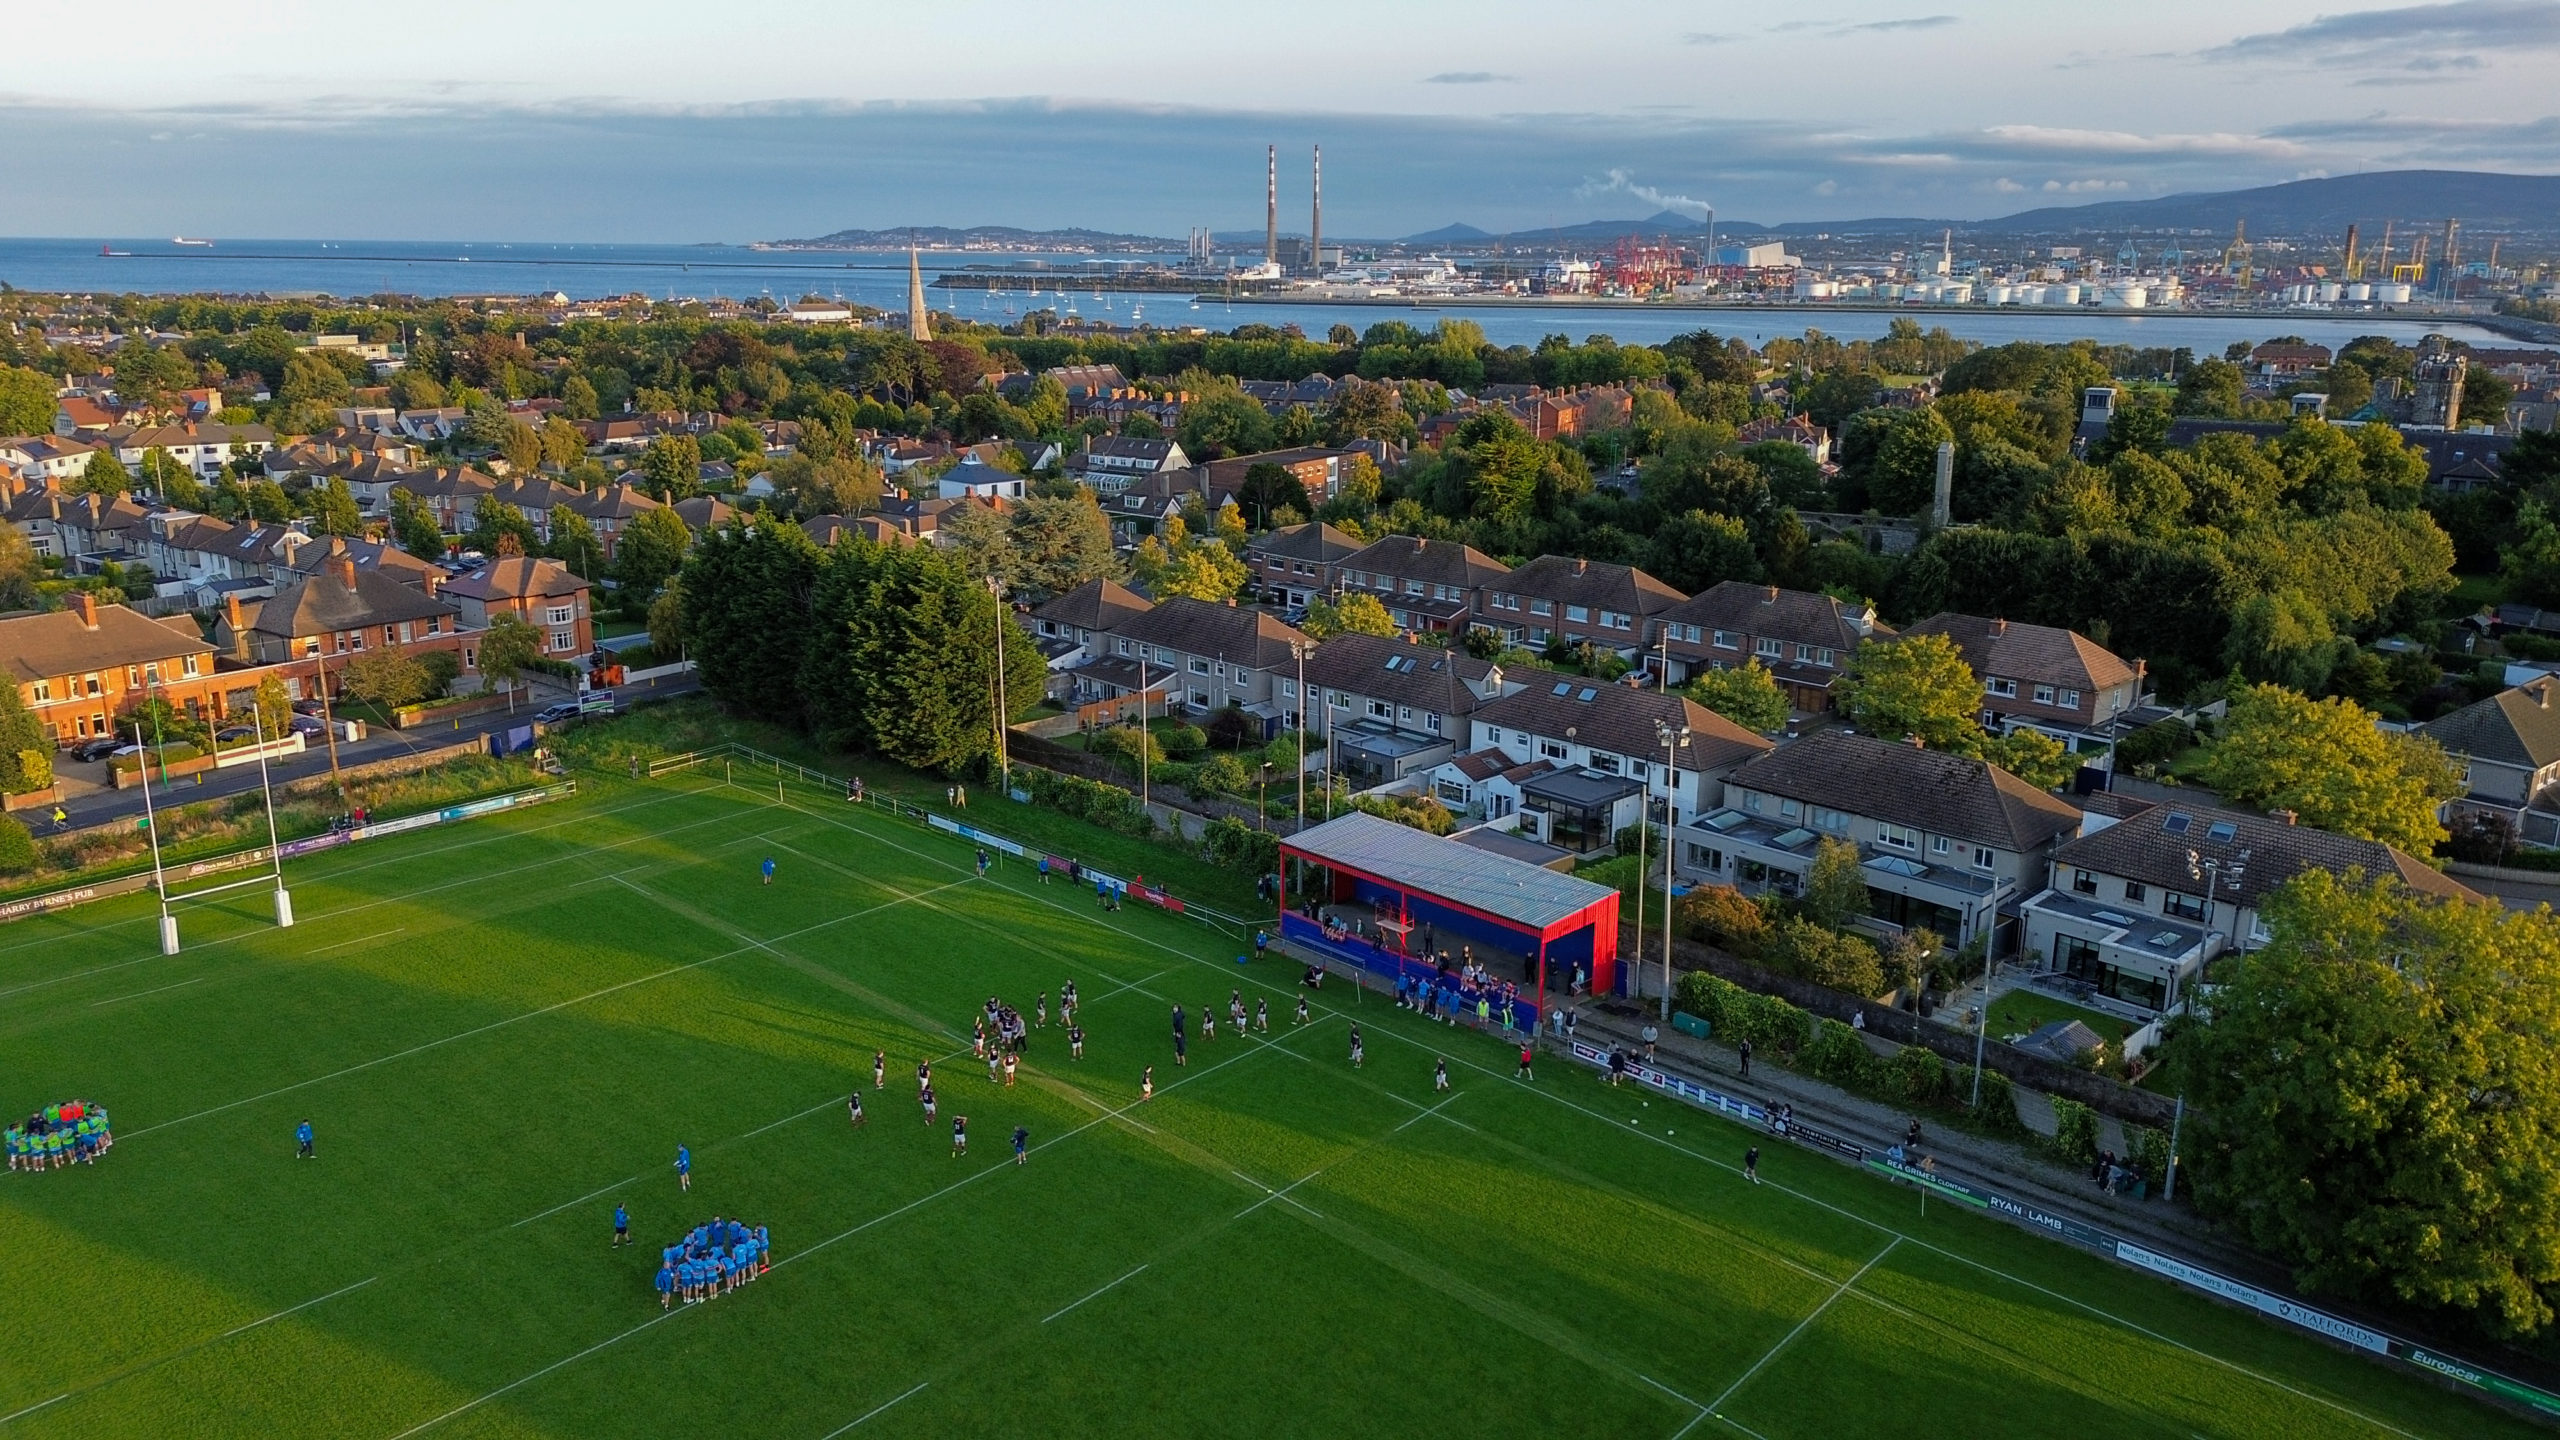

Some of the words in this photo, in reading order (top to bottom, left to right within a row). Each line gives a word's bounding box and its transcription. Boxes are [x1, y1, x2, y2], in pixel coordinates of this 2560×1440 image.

[0, 903, 31, 916] HARRY
[33, 893, 73, 909] BYRNE'S
[74, 889, 94, 900] PUB
[1802, 1128, 1838, 1145] HAMPSHIRE
[1887, 1159, 1903, 1171] REA
[1905, 1165, 1936, 1182] GRIMES
[1938, 1178, 1970, 1195] CLONTARF
[1990, 1196, 2022, 1215] RYAN
[2028, 1210, 2062, 1230] LAMB
[2293, 1308, 2374, 1344] STAFFORDS
[2412, 1350, 2482, 1383] Europcar
